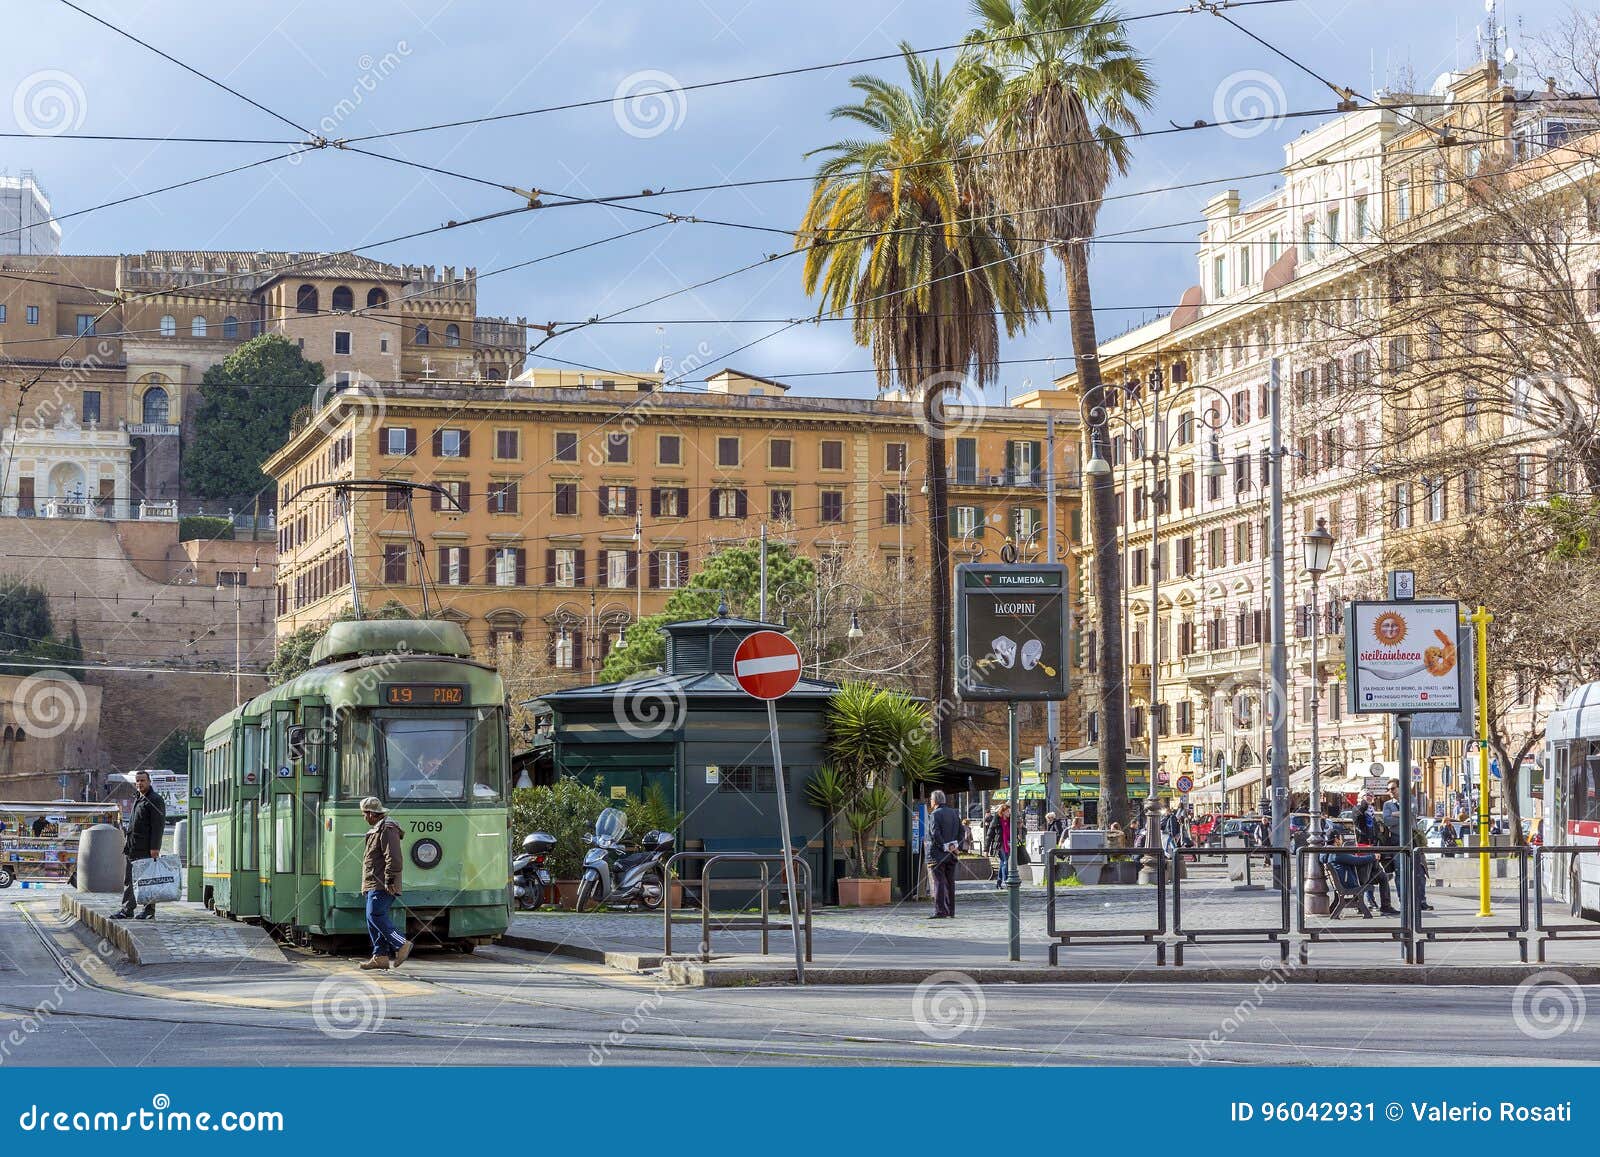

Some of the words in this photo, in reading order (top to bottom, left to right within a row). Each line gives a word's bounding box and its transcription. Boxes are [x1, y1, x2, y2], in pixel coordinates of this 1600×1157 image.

[999, 576, 1044, 584] ITALMEDIA
[995, 603, 1035, 614] IACOPINI
[1360, 649, 1421, 661] siciliainbocca
[390, 687, 413, 702] 19
[410, 820, 443, 833] 7069
